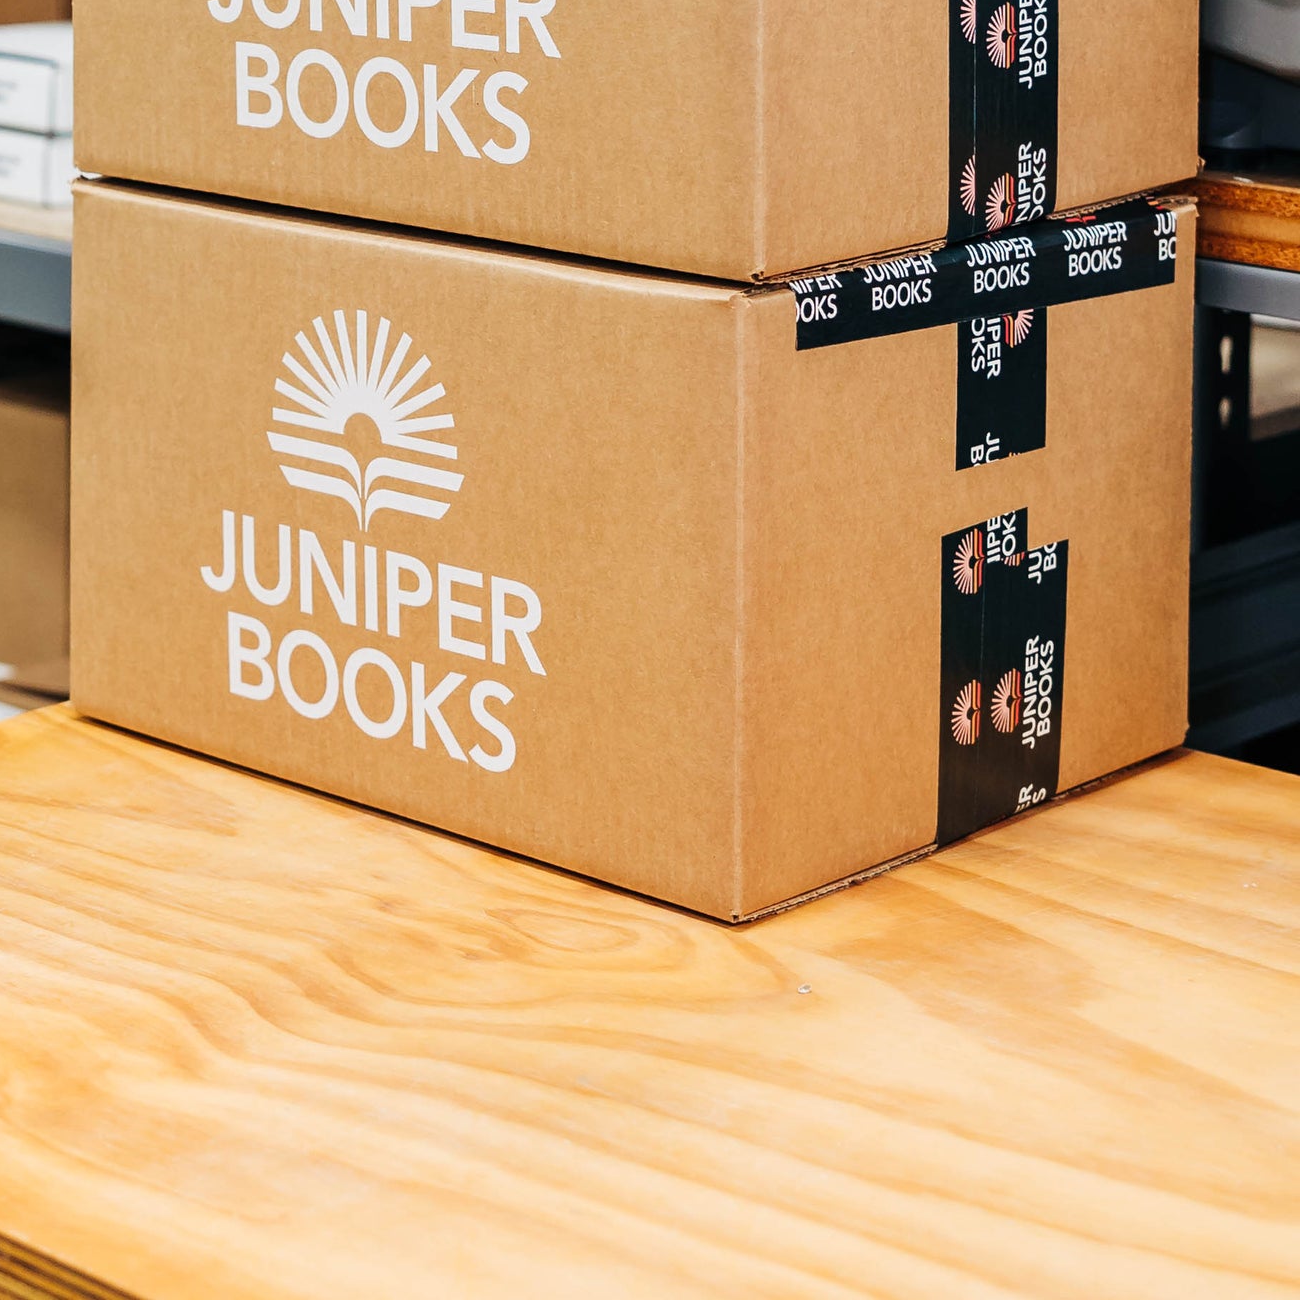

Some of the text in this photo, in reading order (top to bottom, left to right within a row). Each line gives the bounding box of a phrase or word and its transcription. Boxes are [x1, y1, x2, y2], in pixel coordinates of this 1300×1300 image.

[235, 41, 531, 165] BOOKS
[1015, 141, 1032, 224] NIPER
[1028, 148, 1047, 221] OOKS
[966, 236, 1037, 268] JUNIPER
[1063, 220, 1127, 252] JUNIPER
[1068, 246, 1122, 277] BOOKS
[863, 253, 937, 284] JUNIPER
[871, 278, 932, 311] BOOKS
[973, 262, 1030, 294] BOOKS
[971, 318, 986, 373] OKS
[986, 317, 1001, 380] IPER
[200, 509, 547, 677] JUNIPER
[228, 611, 516, 773] BOOKS
[1022, 635, 1040, 750] JUNIPER
[1036, 639, 1054, 737] BOOKS
